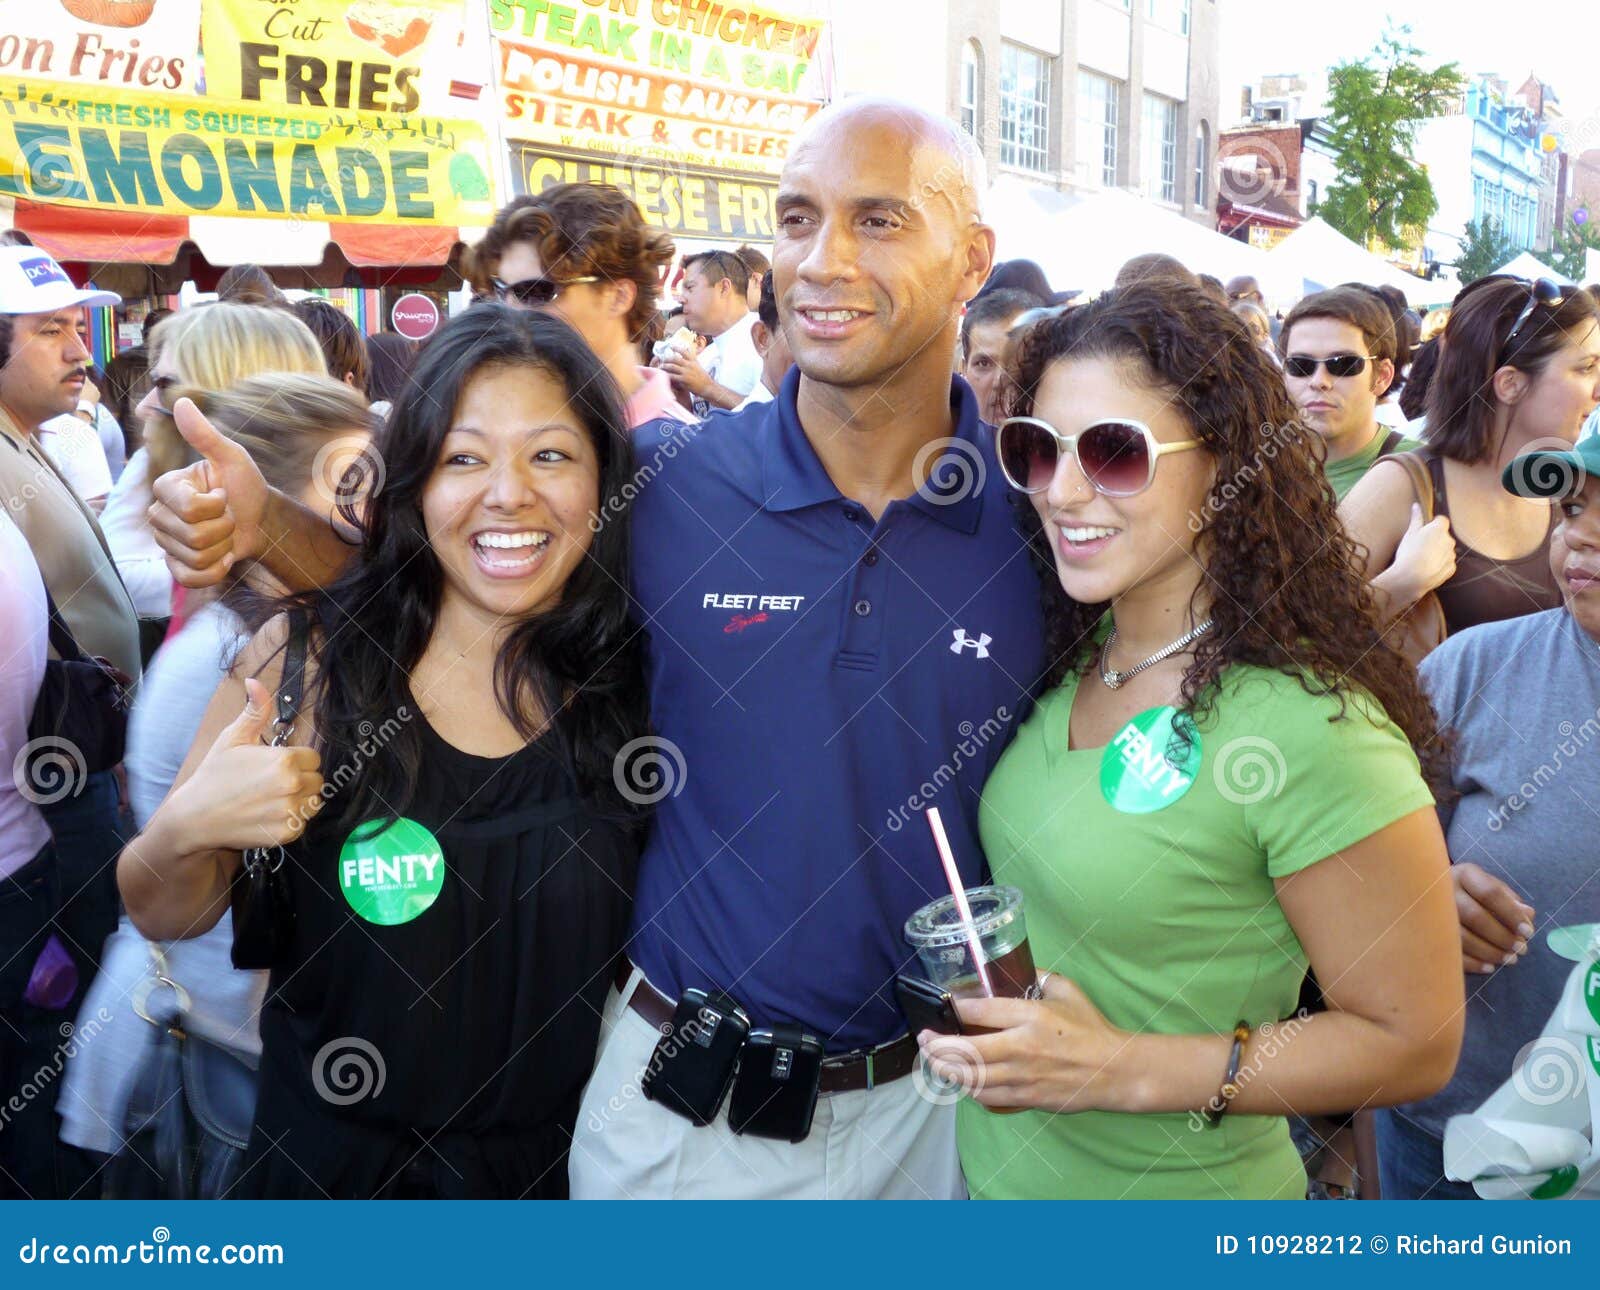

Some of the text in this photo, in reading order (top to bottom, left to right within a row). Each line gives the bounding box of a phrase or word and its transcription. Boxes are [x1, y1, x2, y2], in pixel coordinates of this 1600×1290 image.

[264, 8, 332, 40] Cut
[490, 0, 640, 62] STEAK
[649, 31, 692, 74] IN
[701, 45, 732, 83] A
[652, 0, 820, 59] CHICKEN
[69, 32, 185, 90] Fries
[240, 41, 421, 113] FRIES
[504, 49, 651, 109] POLISH
[77, 100, 321, 139] FRESH SQUEEZED
[504, 93, 633, 137] STEAK
[652, 119, 669, 144] &
[702, 593, 804, 611] FLEET FEET
[1113, 723, 1192, 797] FENTY
[343, 853, 440, 888] FENTY
